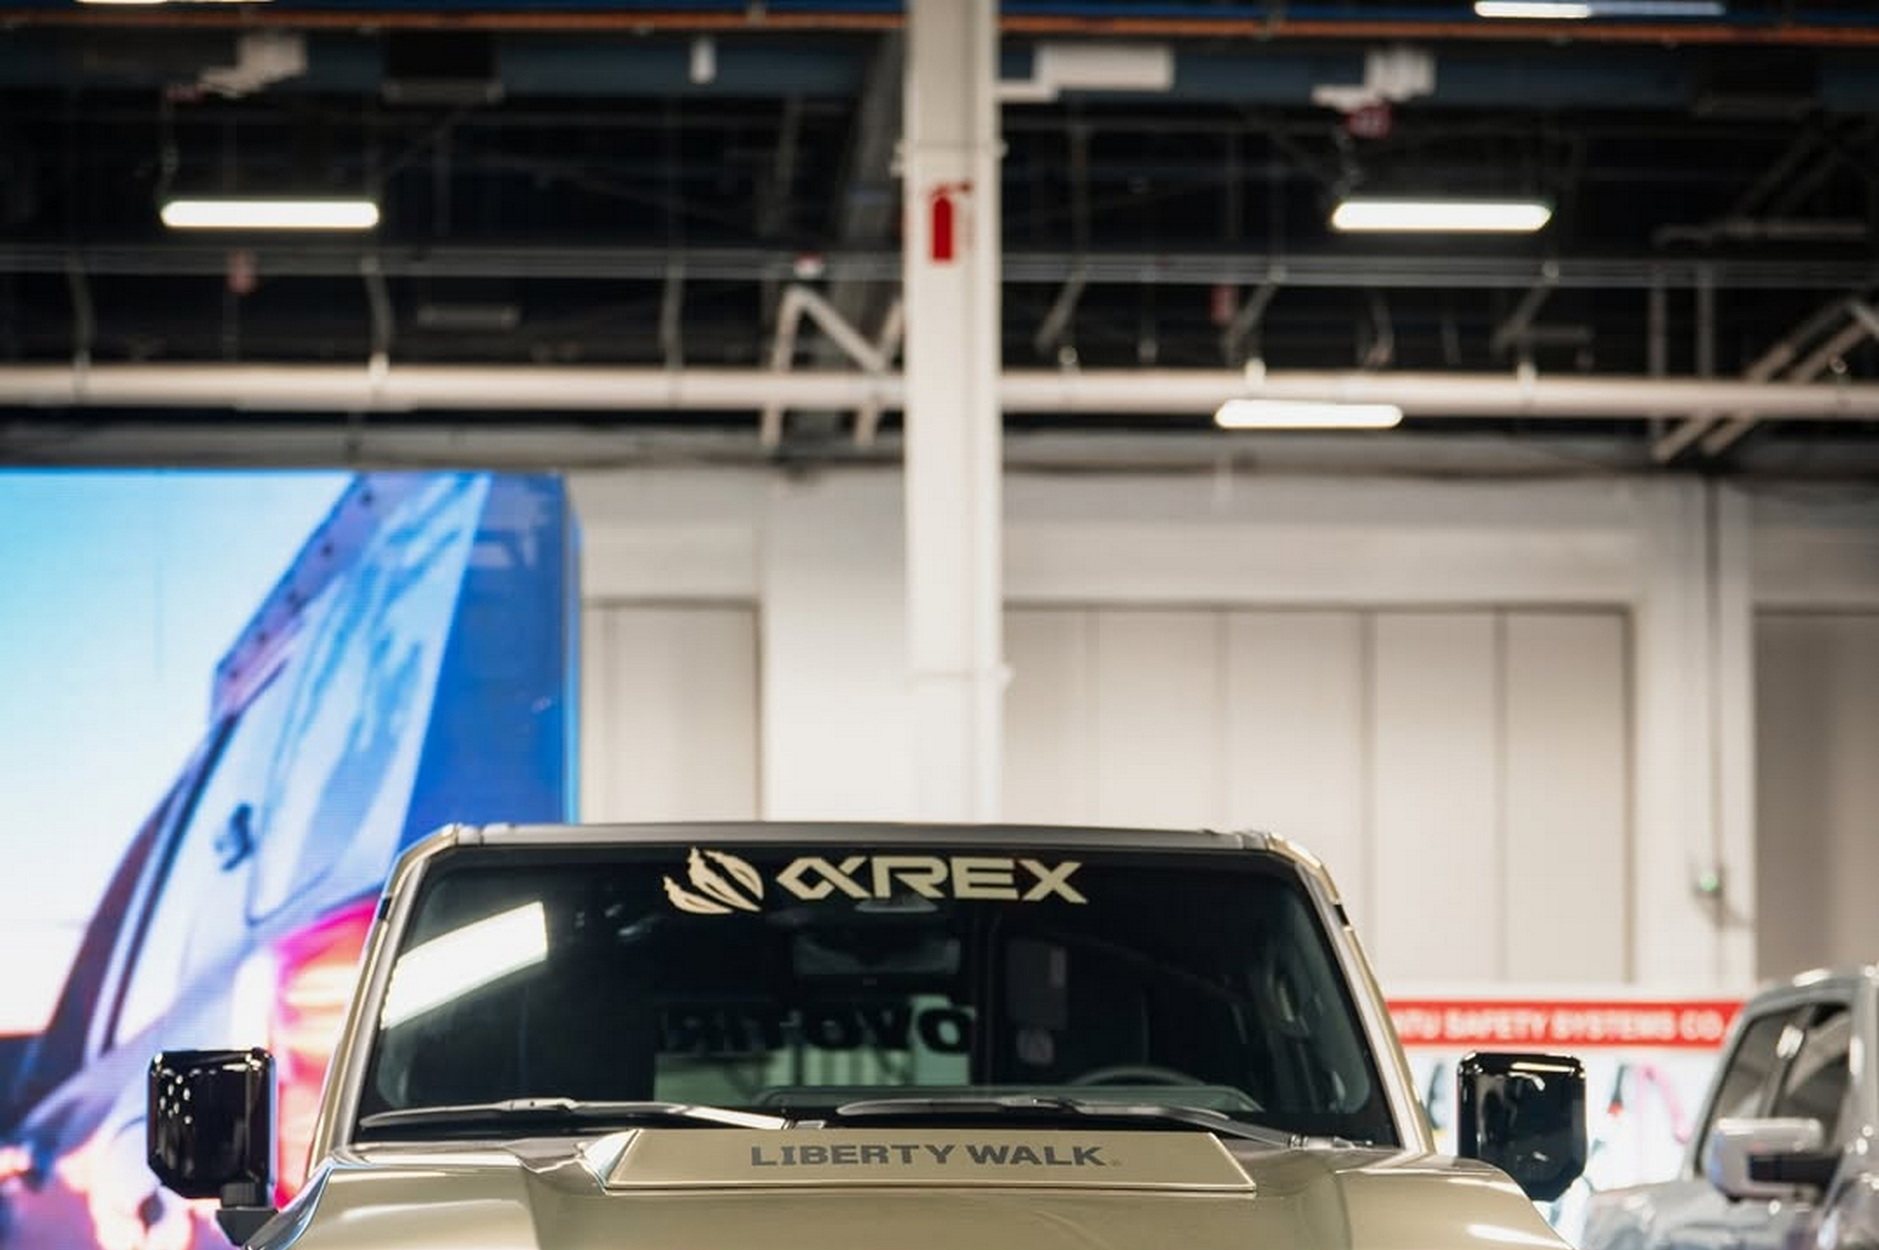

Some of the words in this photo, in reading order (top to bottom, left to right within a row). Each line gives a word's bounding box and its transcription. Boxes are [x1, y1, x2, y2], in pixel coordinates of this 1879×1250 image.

[1445, 1010, 1548, 1039] SAFETY
[1552, 1010, 1676, 1039] SYSTEMS
[750, 1143, 956, 1167] LIBERTY
[965, 1144, 1107, 1167] WALK
